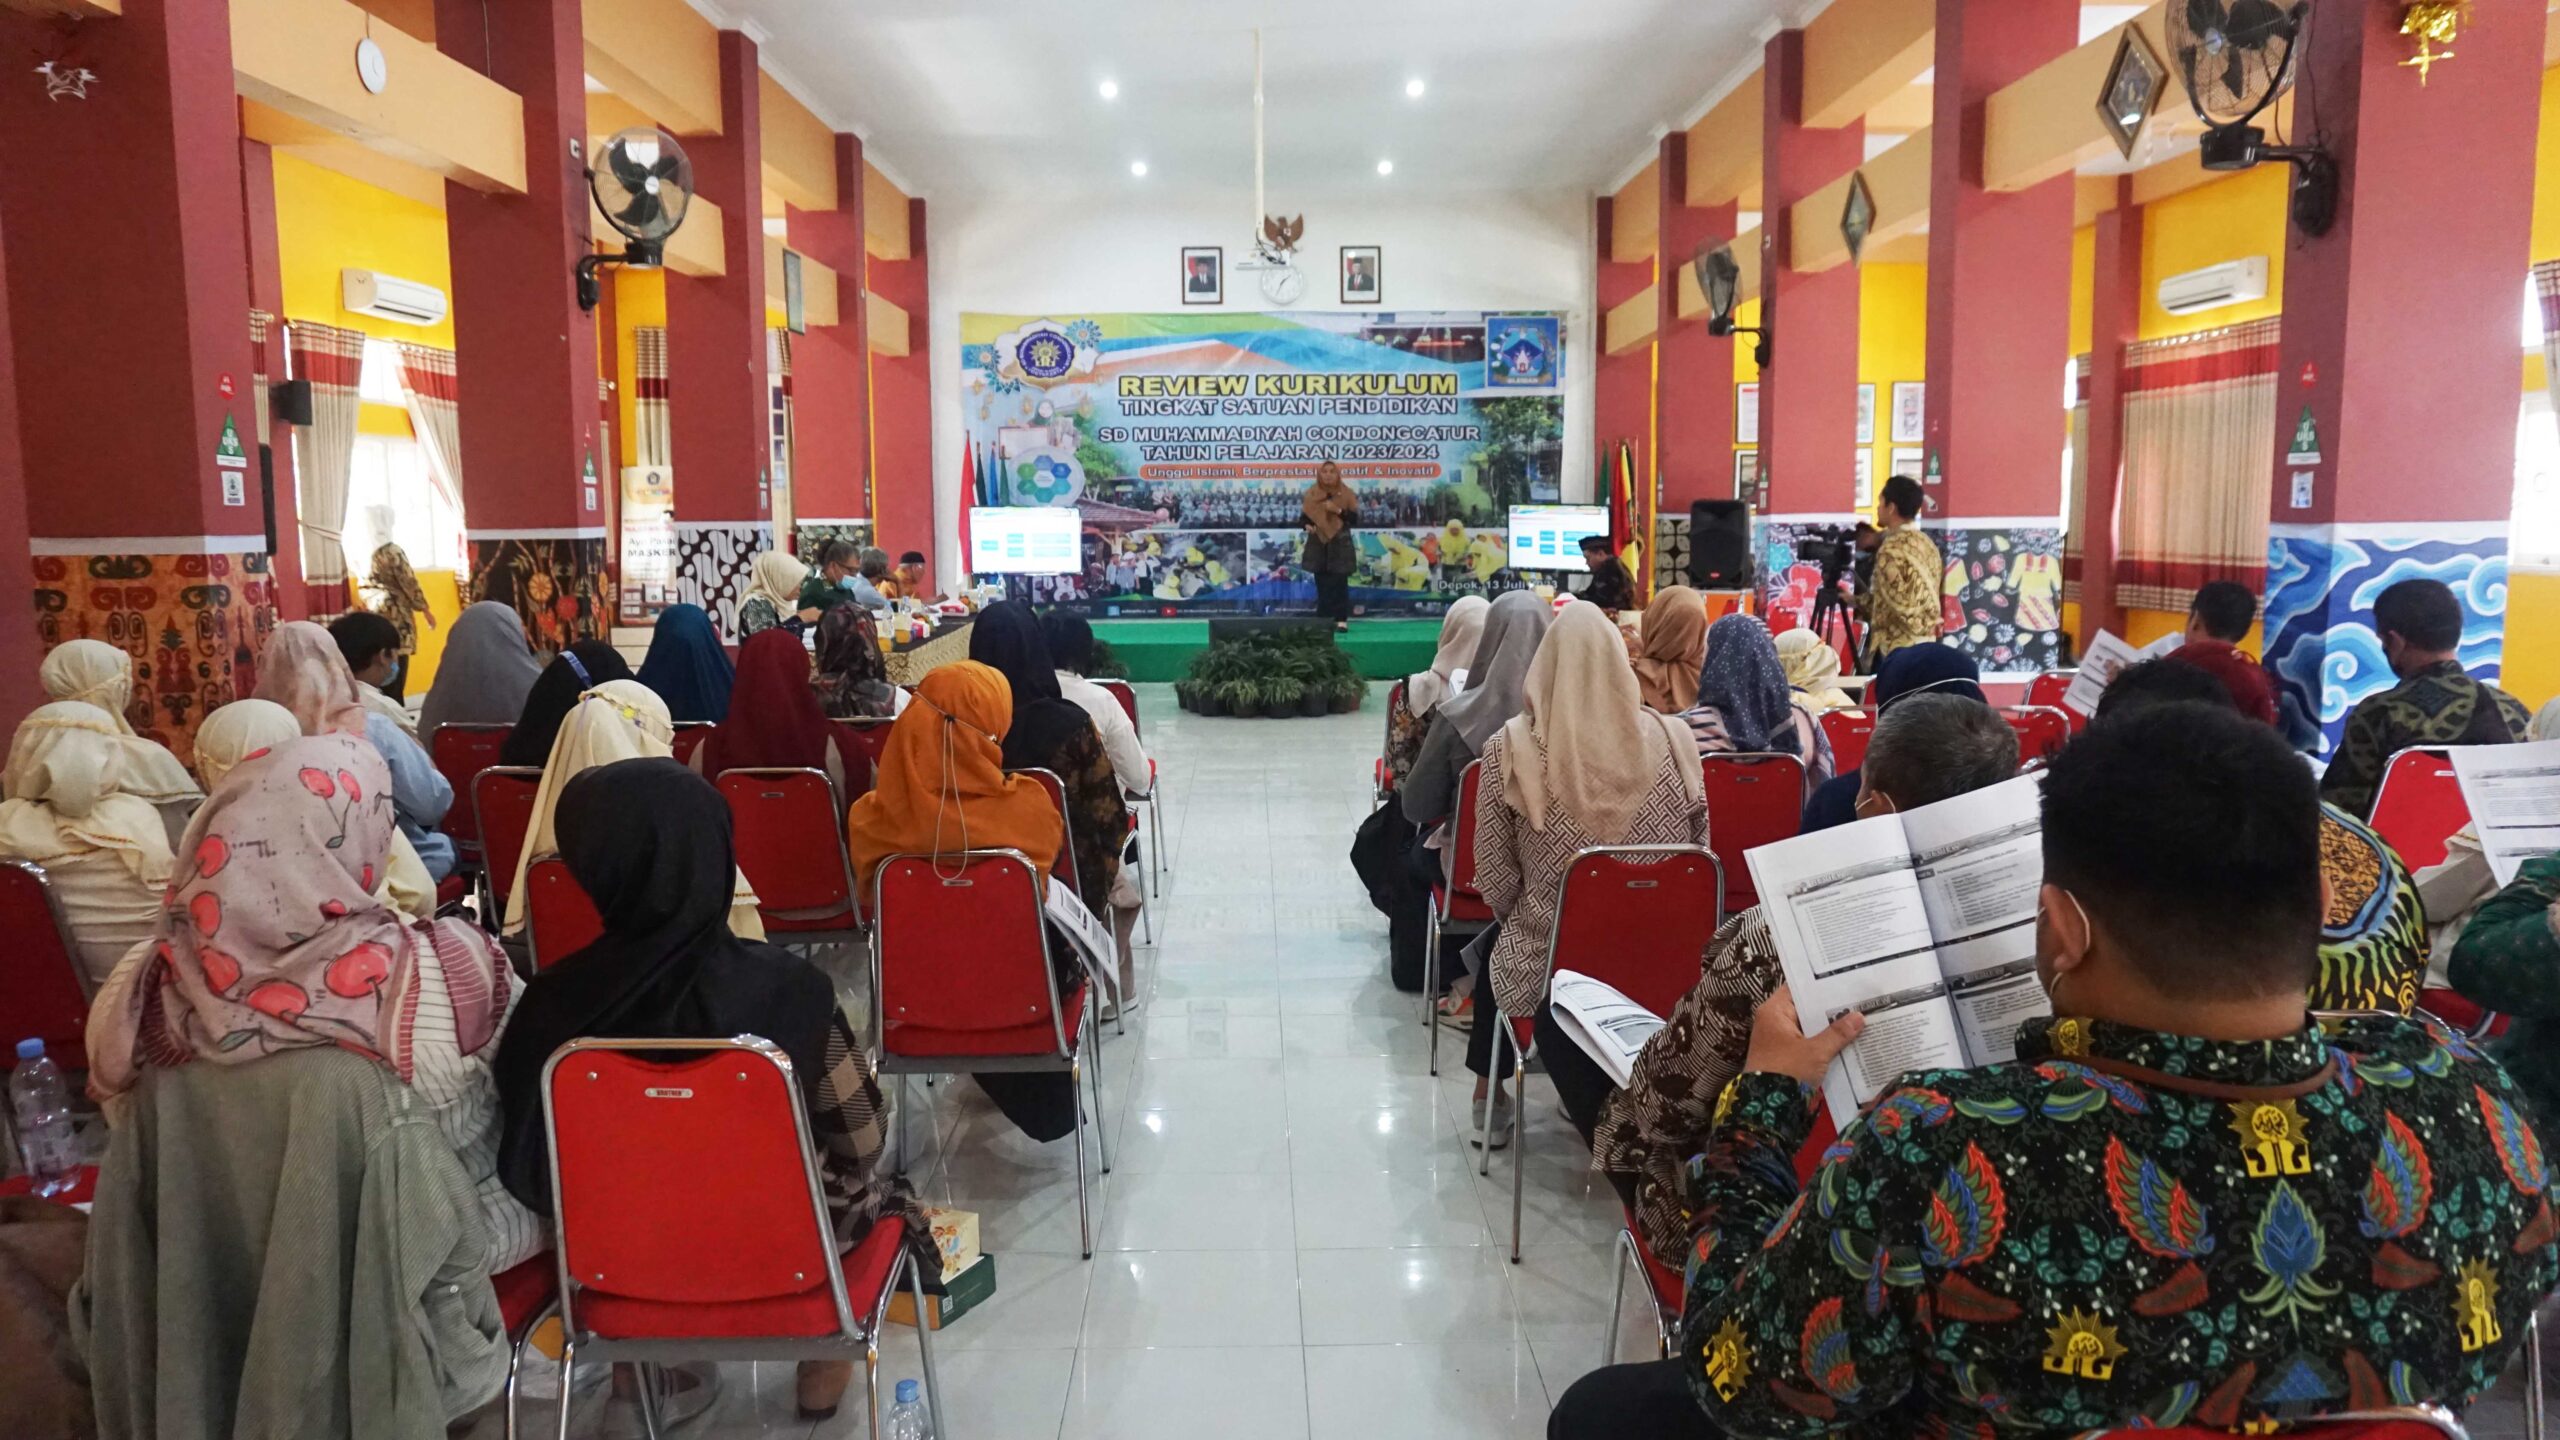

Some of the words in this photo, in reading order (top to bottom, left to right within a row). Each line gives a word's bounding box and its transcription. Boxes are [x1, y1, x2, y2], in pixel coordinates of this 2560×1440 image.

[1119, 375, 1248, 396] REVIEW
[1256, 374, 1458, 396] KURIKULUM
[1120, 399, 1217, 416] TINGKAT
[1223, 399, 1314, 416] SATUAN
[1319, 398, 1457, 415] PENDIDIKAN
[1099, 427, 1129, 442] SD
[1133, 426, 1302, 442] MUHAMMADIYAH
[1307, 425, 1480, 441] CONDONGCATUR
[1141, 445, 1212, 460] TAHUN
[1216, 445, 1338, 460] PELAJARAN
[1343, 443, 1439, 459] 2023/2024
[1147, 467, 1193, 478] Unggul
[1374, 466, 1383, 475] &
[1387, 466, 1434, 475] Inovatif
[1439, 580, 1482, 591] Depok,
[1487, 580, 1499, 589] 13
[1503, 580, 1525, 589] Juli
